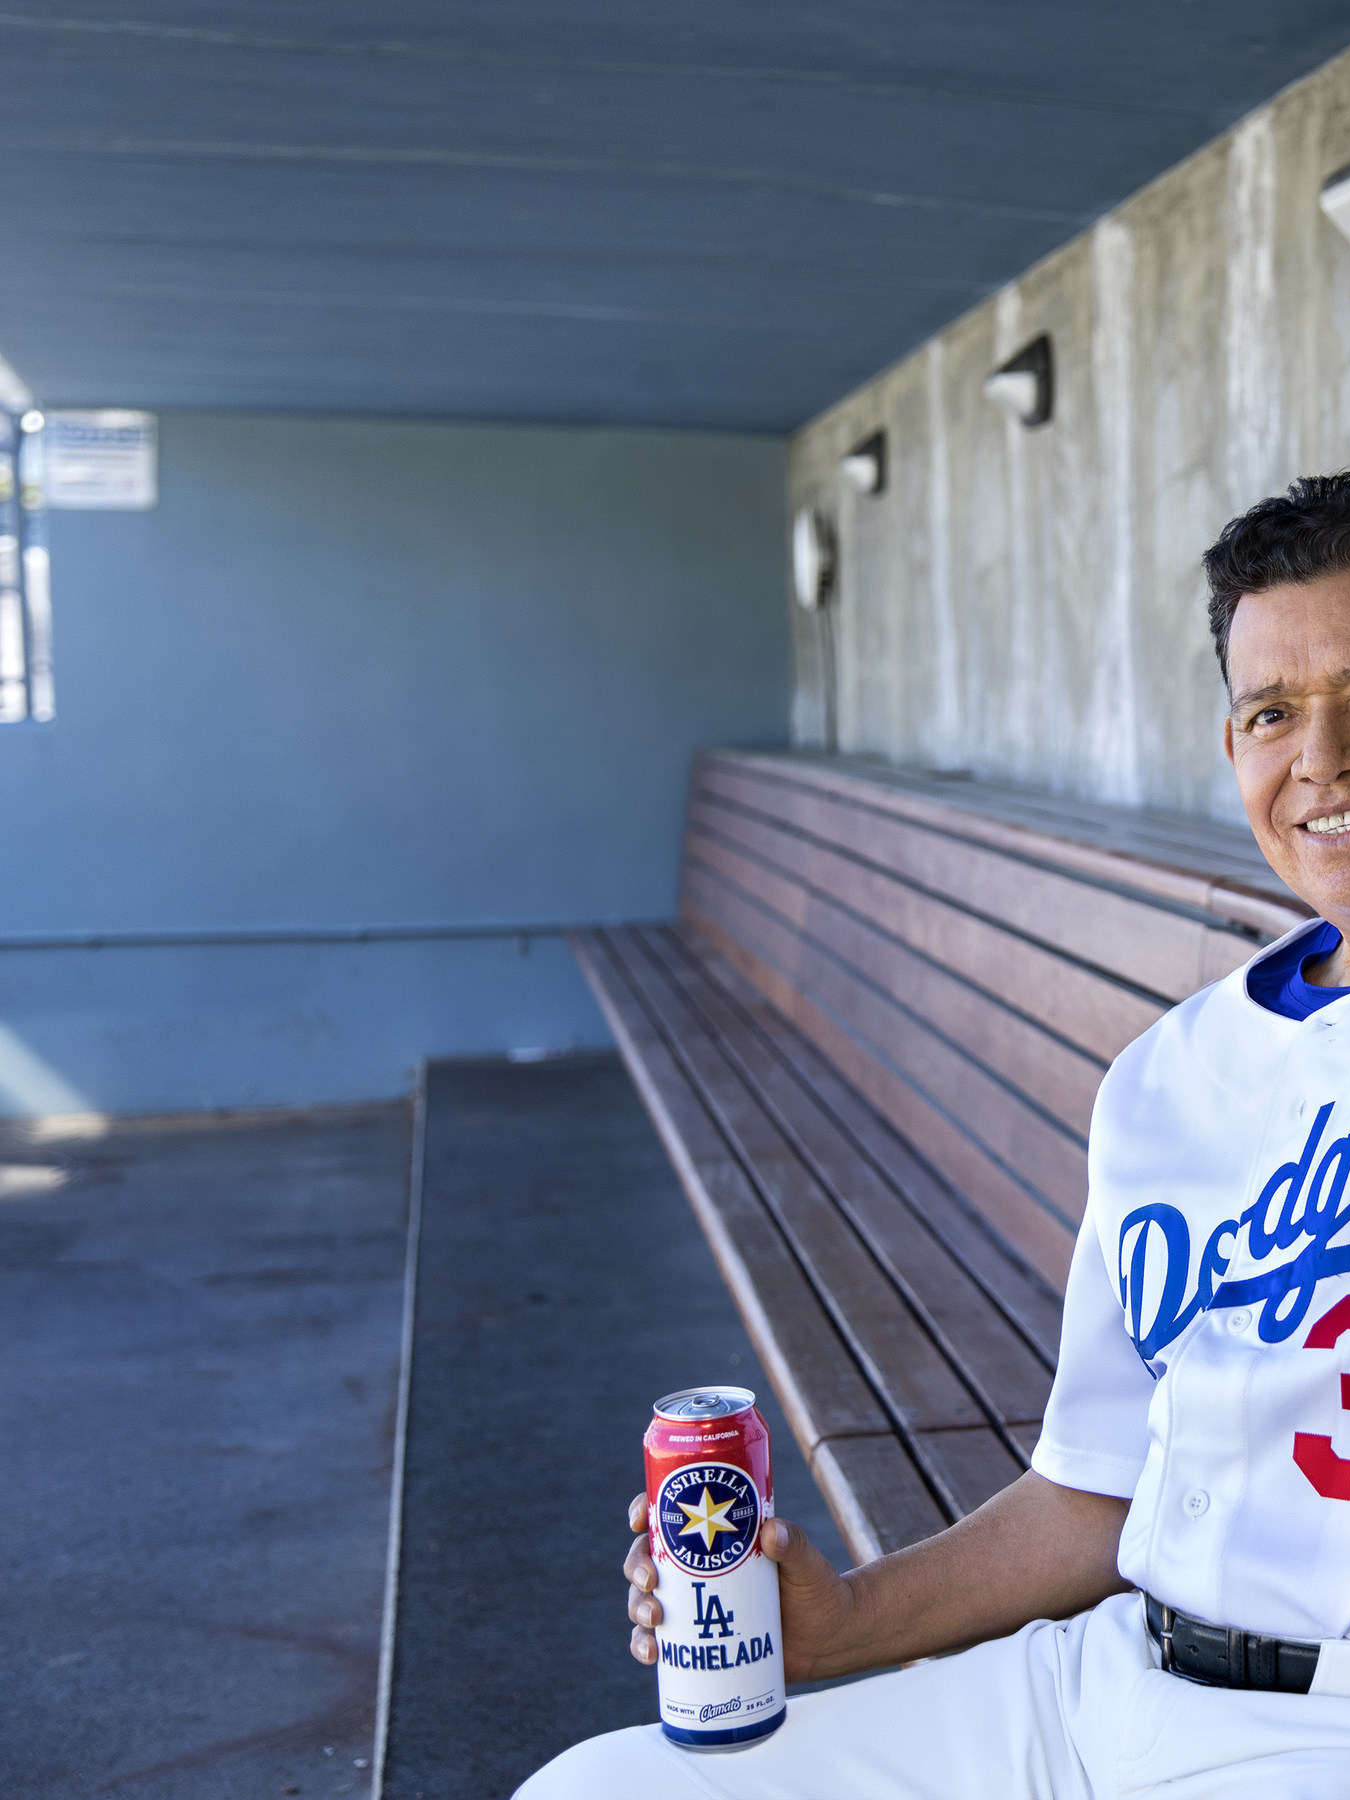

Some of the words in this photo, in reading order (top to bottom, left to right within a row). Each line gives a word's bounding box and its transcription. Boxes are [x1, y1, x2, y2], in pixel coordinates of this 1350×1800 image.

[668, 1434, 694, 1442] BREWED
[695, 1434, 702, 1442] IN
[703, 1429, 739, 1441] CALIFORNIA
[664, 1468, 748, 1502] ESTRELLA
[662, 1513, 683, 1523] CERVEZA
[733, 1507, 754, 1518] DORADA
[674, 1540, 744, 1569] JALISCO
[691, 1582, 734, 1639] LA
[661, 1632, 774, 1671] MICHELADA
[666, 1704, 679, 1713] MADE
[746, 1703, 755, 1711] 25
